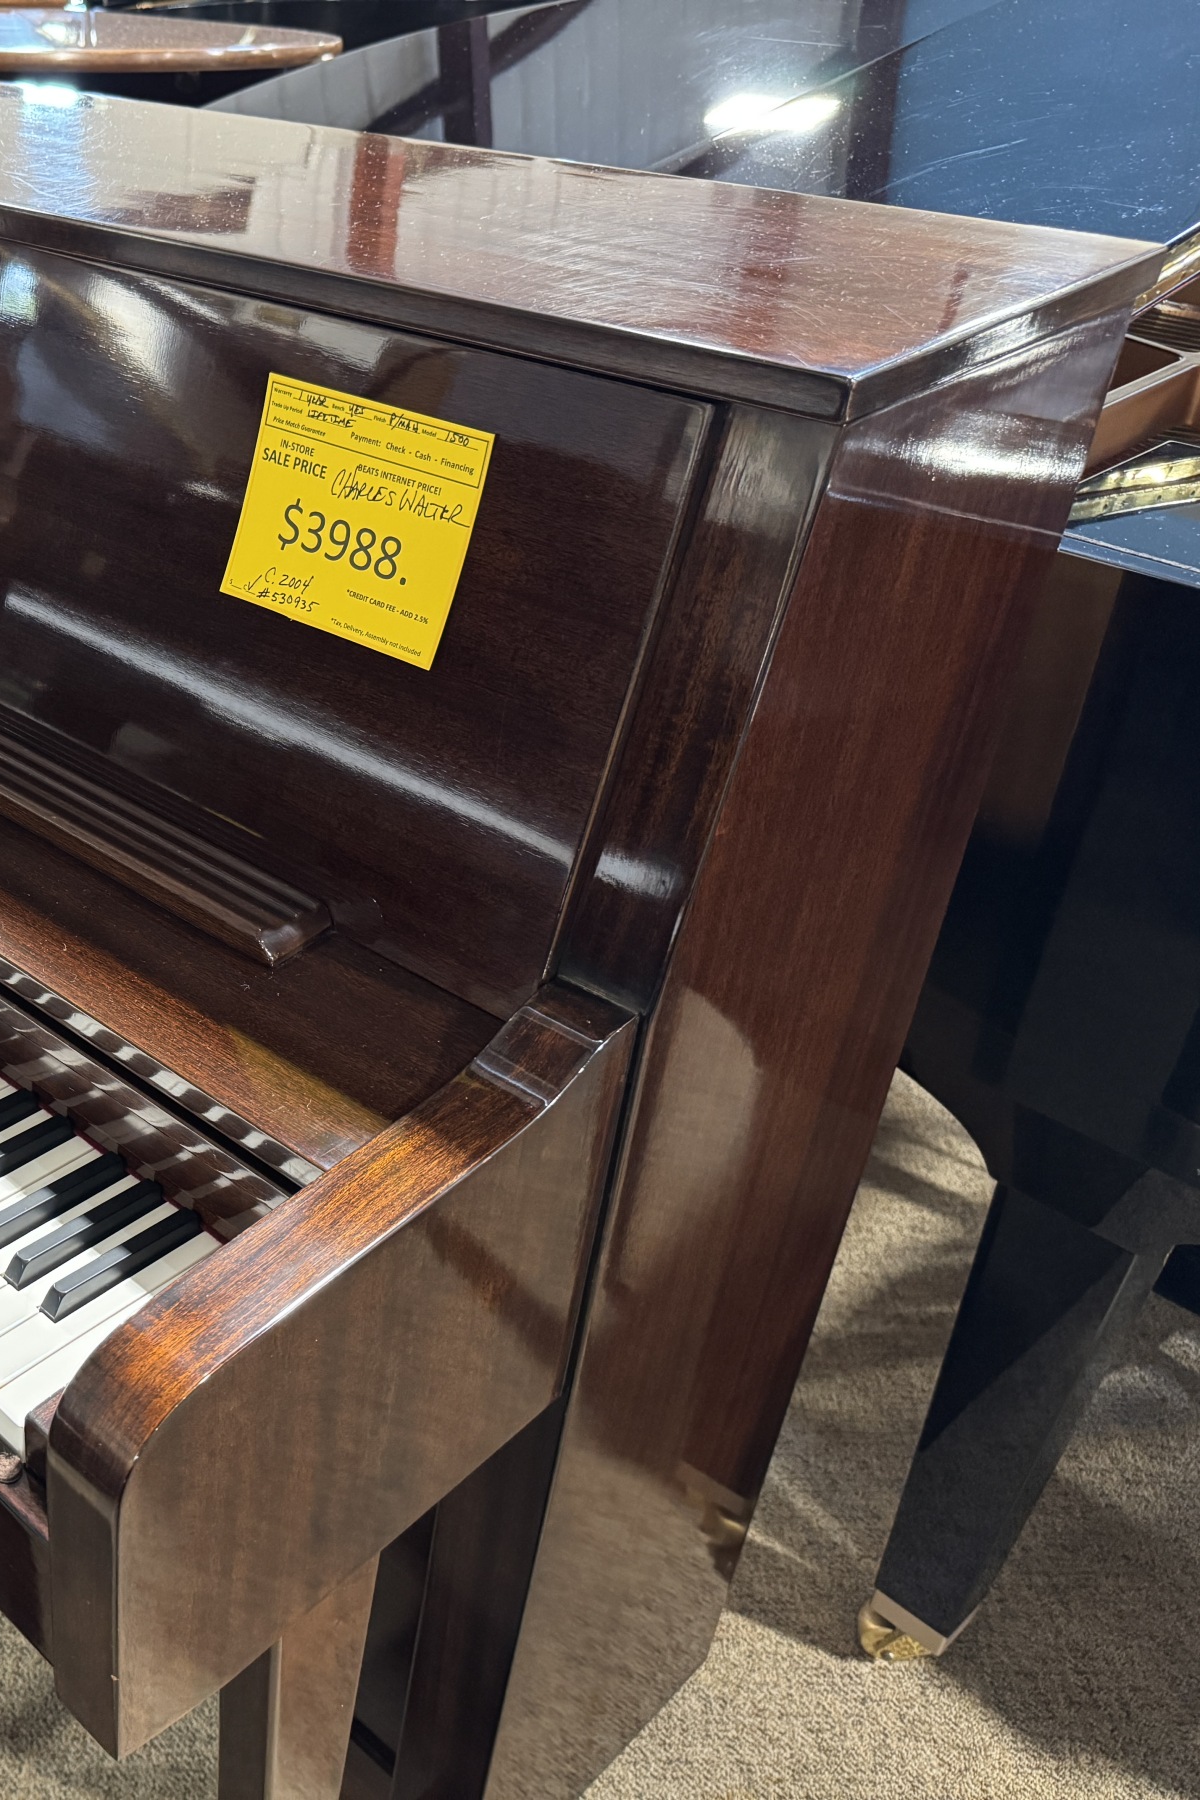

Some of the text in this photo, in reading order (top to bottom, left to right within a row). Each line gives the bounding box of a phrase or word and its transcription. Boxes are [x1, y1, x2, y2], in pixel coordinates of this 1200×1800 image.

[272, 400, 282, 408] Trade
[283, 403, 289, 411] Up
[290, 405, 303, 414] Period
[273, 416, 284, 424] Price
[285, 419, 301, 429] Match
[274, 387, 292, 397] Warranty
[349, 404, 365, 417] YES
[373, 415, 387, 423] Finish
[421, 428, 437, 438] Model
[445, 431, 470, 447] 1500
[262, 447, 328, 480] SALE PRICE
[280, 438, 316, 457] IN-STORE
[350, 431, 382, 447] Payment:
[385, 442, 406, 455] Check
[414, 450, 432, 462] Cash
[440, 457, 475, 476] Financing
[357, 463, 442, 496] BEATS INTERNET PRICE!
[331, 466, 470, 528] CHARLES WALTER
[277, 498, 408, 587] $3988.
[256, 588, 320, 612] #530935
[279, 574, 314, 595] 2004
[369, 597, 385, 609] CARD
[385, 603, 396, 613] FEE
[399, 609, 414, 619] ADD
[414, 614, 429, 625] 2.5%
[343, 622, 364, 636] Delivery,
[365, 631, 389, 646] Assembly
[389, 641, 398, 649] not
[398, 643, 422, 657] included
